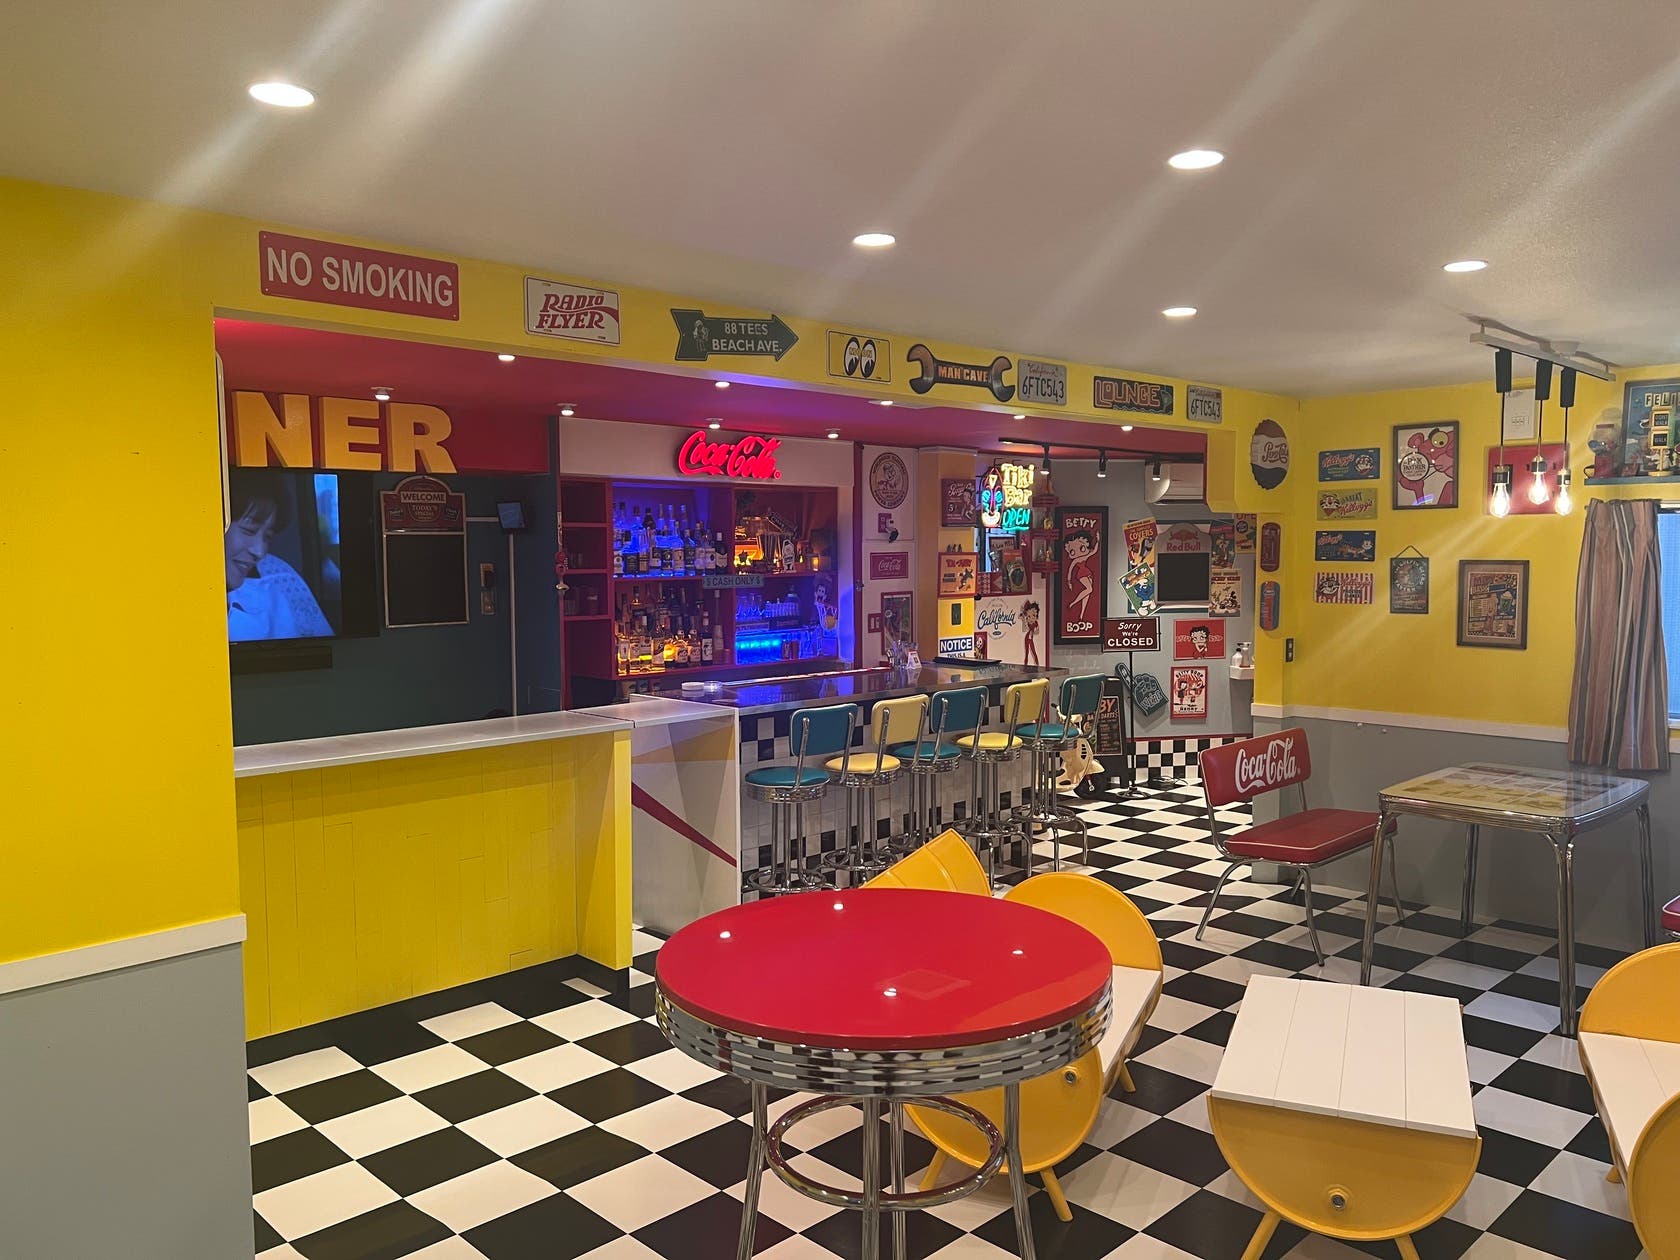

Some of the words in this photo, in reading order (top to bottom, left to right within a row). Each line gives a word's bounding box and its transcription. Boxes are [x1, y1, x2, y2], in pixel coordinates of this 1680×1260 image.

[266, 247, 312, 286] NO
[321, 256, 453, 307] SMOKING
[540, 293, 605, 313] RADIO
[536, 311, 606, 330] FLYER
[724, 322, 738, 334] 88
[739, 323, 768, 336] TEES
[712, 339, 755, 352] BEACH
[757, 341, 783, 352] AVE.
[938, 366, 962, 379] MAN
[962, 368, 988, 382] CAVE
[1022, 376, 1065, 399] 6FTC543
[1095, 379, 1161, 408] LOUNGE
[1646, 393, 1680, 406] FELI
[1190, 399, 1221, 418] 6FTC543
[1001, 463, 1034, 489] Tiki
[402, 491, 446, 502] WELCOME
[1002, 487, 1033, 507] Bar
[1002, 508, 1030, 526] OPEN
[1065, 517, 1097, 528] BETTY
[1129, 528, 1154, 541] COVERS
[1166, 542, 1184, 551] Red
[1185, 542, 1201, 551] Bull
[713, 577, 734, 586] CASH
[735, 576, 755, 585] ONLY
[977, 609, 1016, 631] California
[1066, 621, 1093, 632] BOOP
[1117, 621, 1142, 631] Sorry
[940, 638, 972, 652] NOTICE
[1107, 637, 1154, 647] CLOSED
[1234, 736, 1297, 793] Coca-Cola
